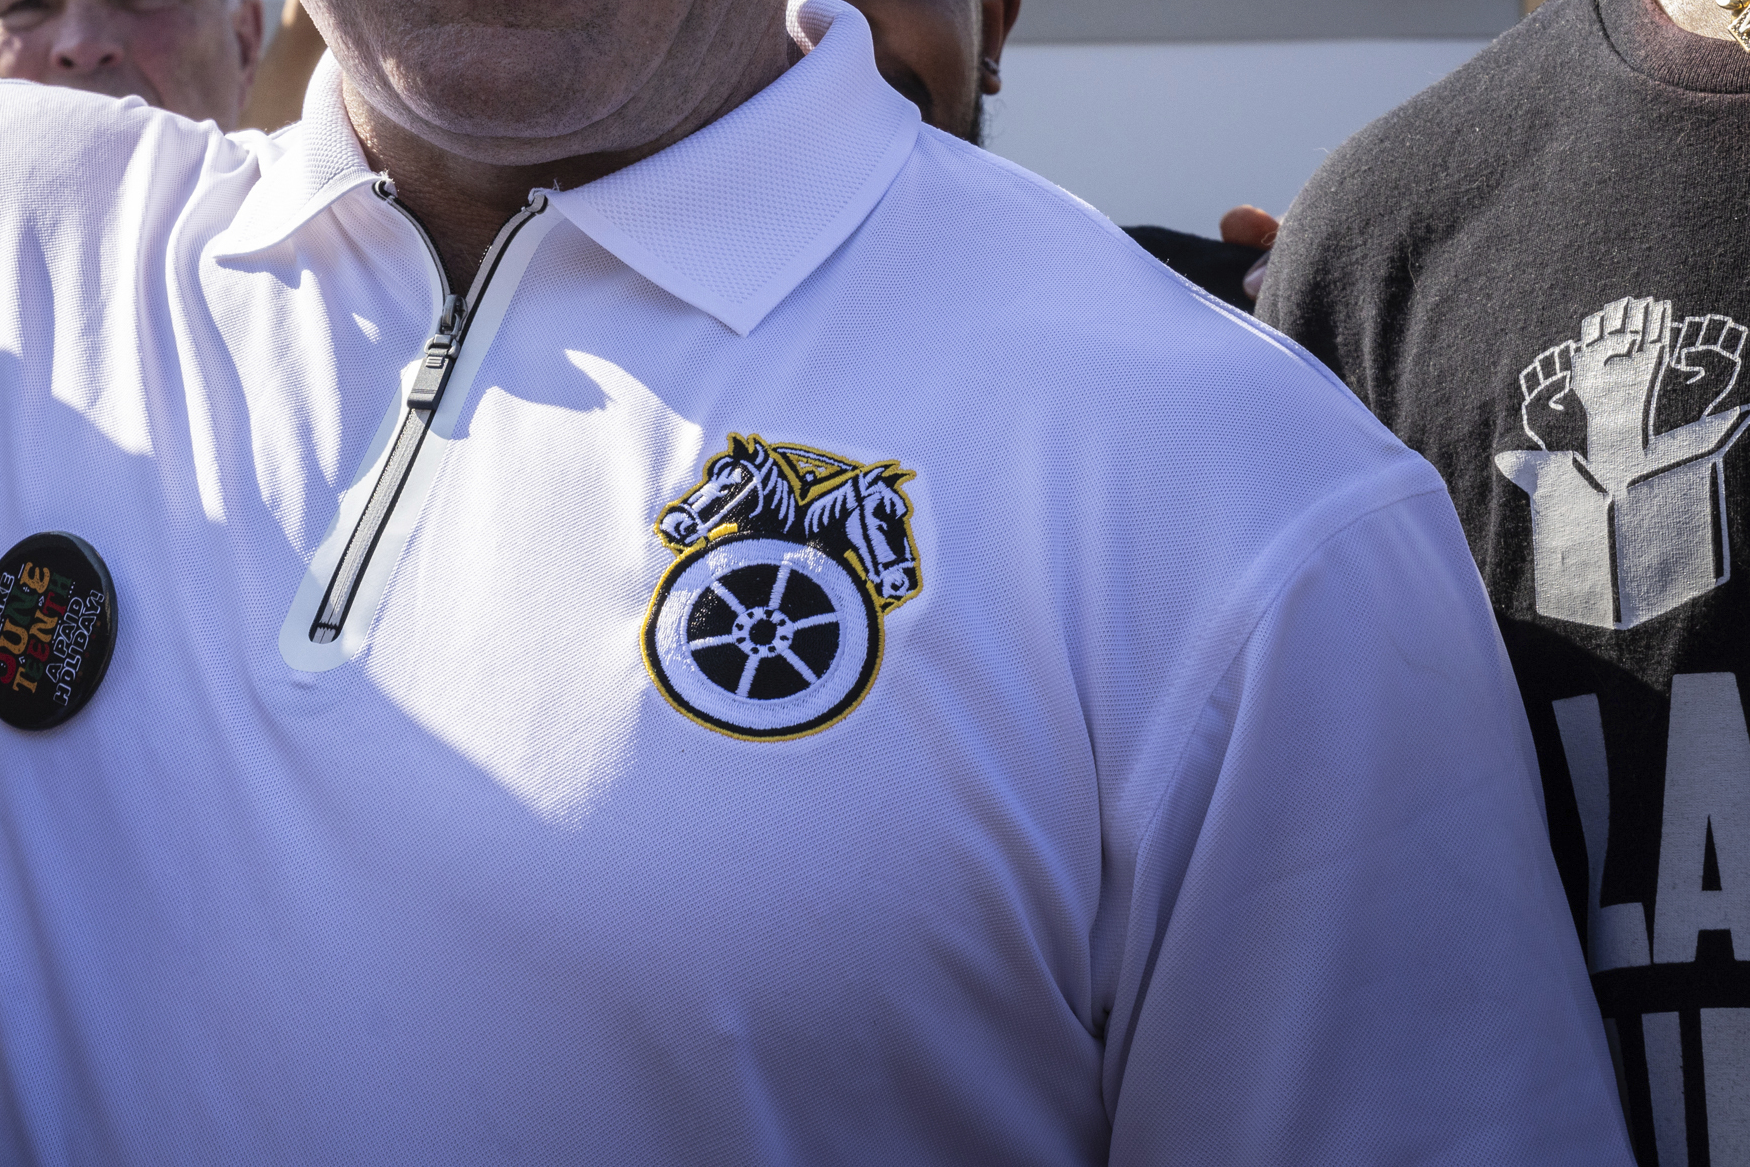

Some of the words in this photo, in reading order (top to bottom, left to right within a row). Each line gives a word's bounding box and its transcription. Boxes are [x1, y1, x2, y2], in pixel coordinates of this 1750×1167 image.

[12, 573, 73, 694] TEENTH
[53, 596, 85, 658] PAID
[53, 589, 105, 706] HOLIDAY!
[46, 662, 64, 683] A
